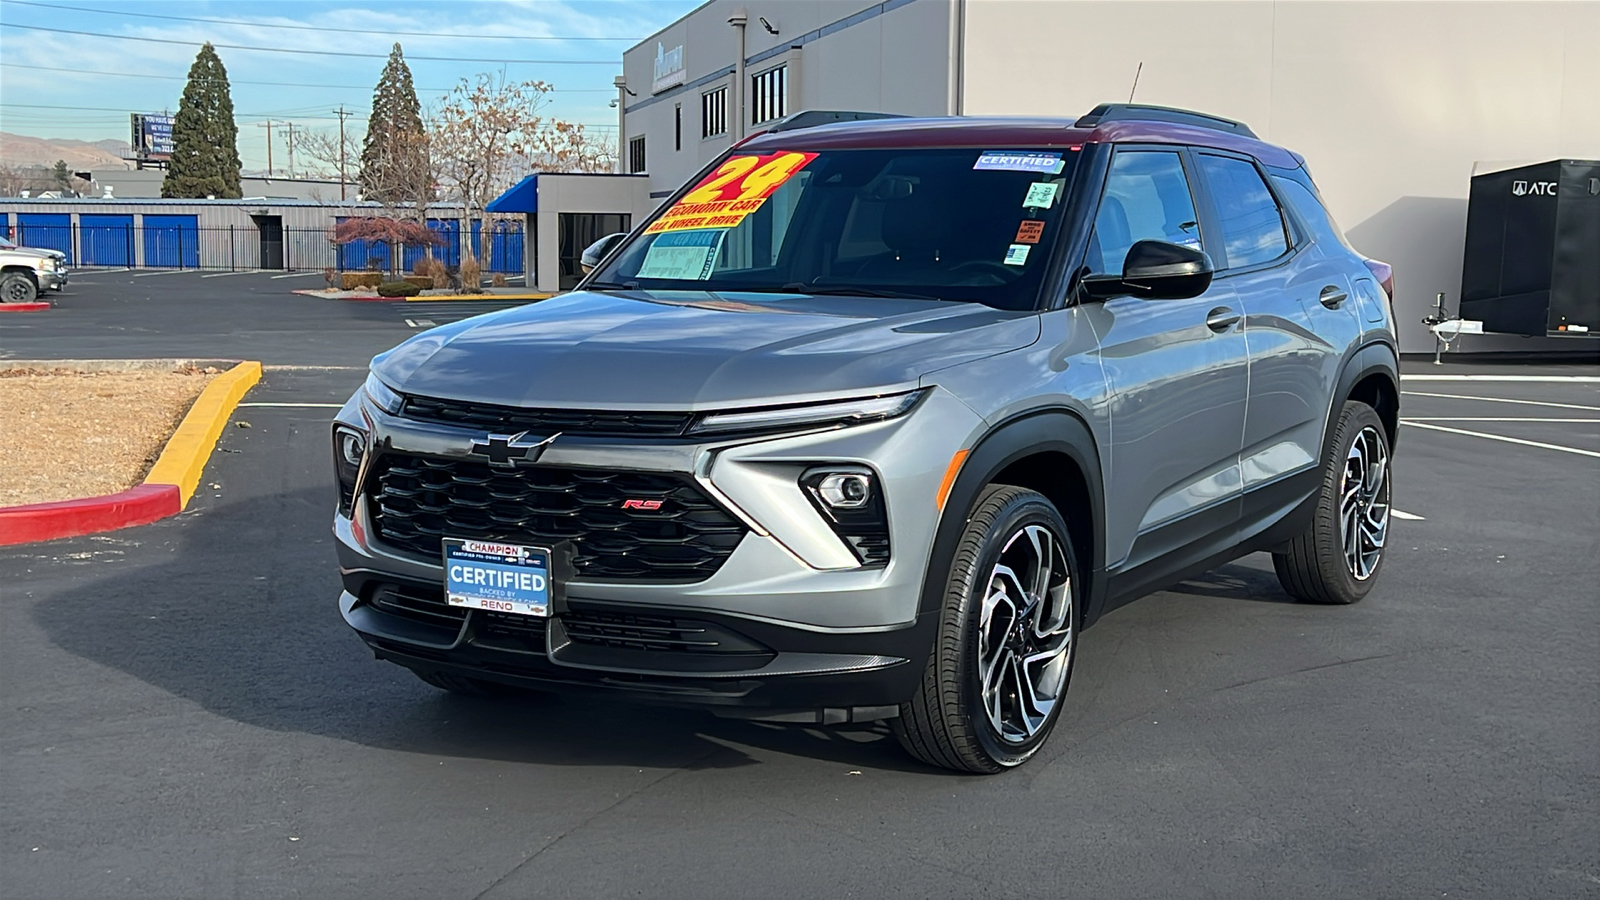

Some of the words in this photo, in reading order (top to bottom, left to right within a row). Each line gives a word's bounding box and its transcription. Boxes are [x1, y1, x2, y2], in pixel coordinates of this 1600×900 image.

[981, 156, 1055, 166] CERTIFIED
[681, 153, 806, 204] 24
[1528, 182, 1557, 195] ATC
[664, 201, 730, 218] ECONOMY
[729, 199, 761, 211] CAR
[647, 221, 669, 232] ALL
[669, 216, 706, 230] WHEEL
[705, 214, 744, 226] DRIVE
[621, 499, 663, 510] RS
[452, 550, 475, 558] CERTIFIED
[469, 542, 519, 556] CHAMPION
[450, 565, 546, 592] CERTIFIED
[479, 587, 506, 597] BACKED
[480, 599, 514, 611] RENO
